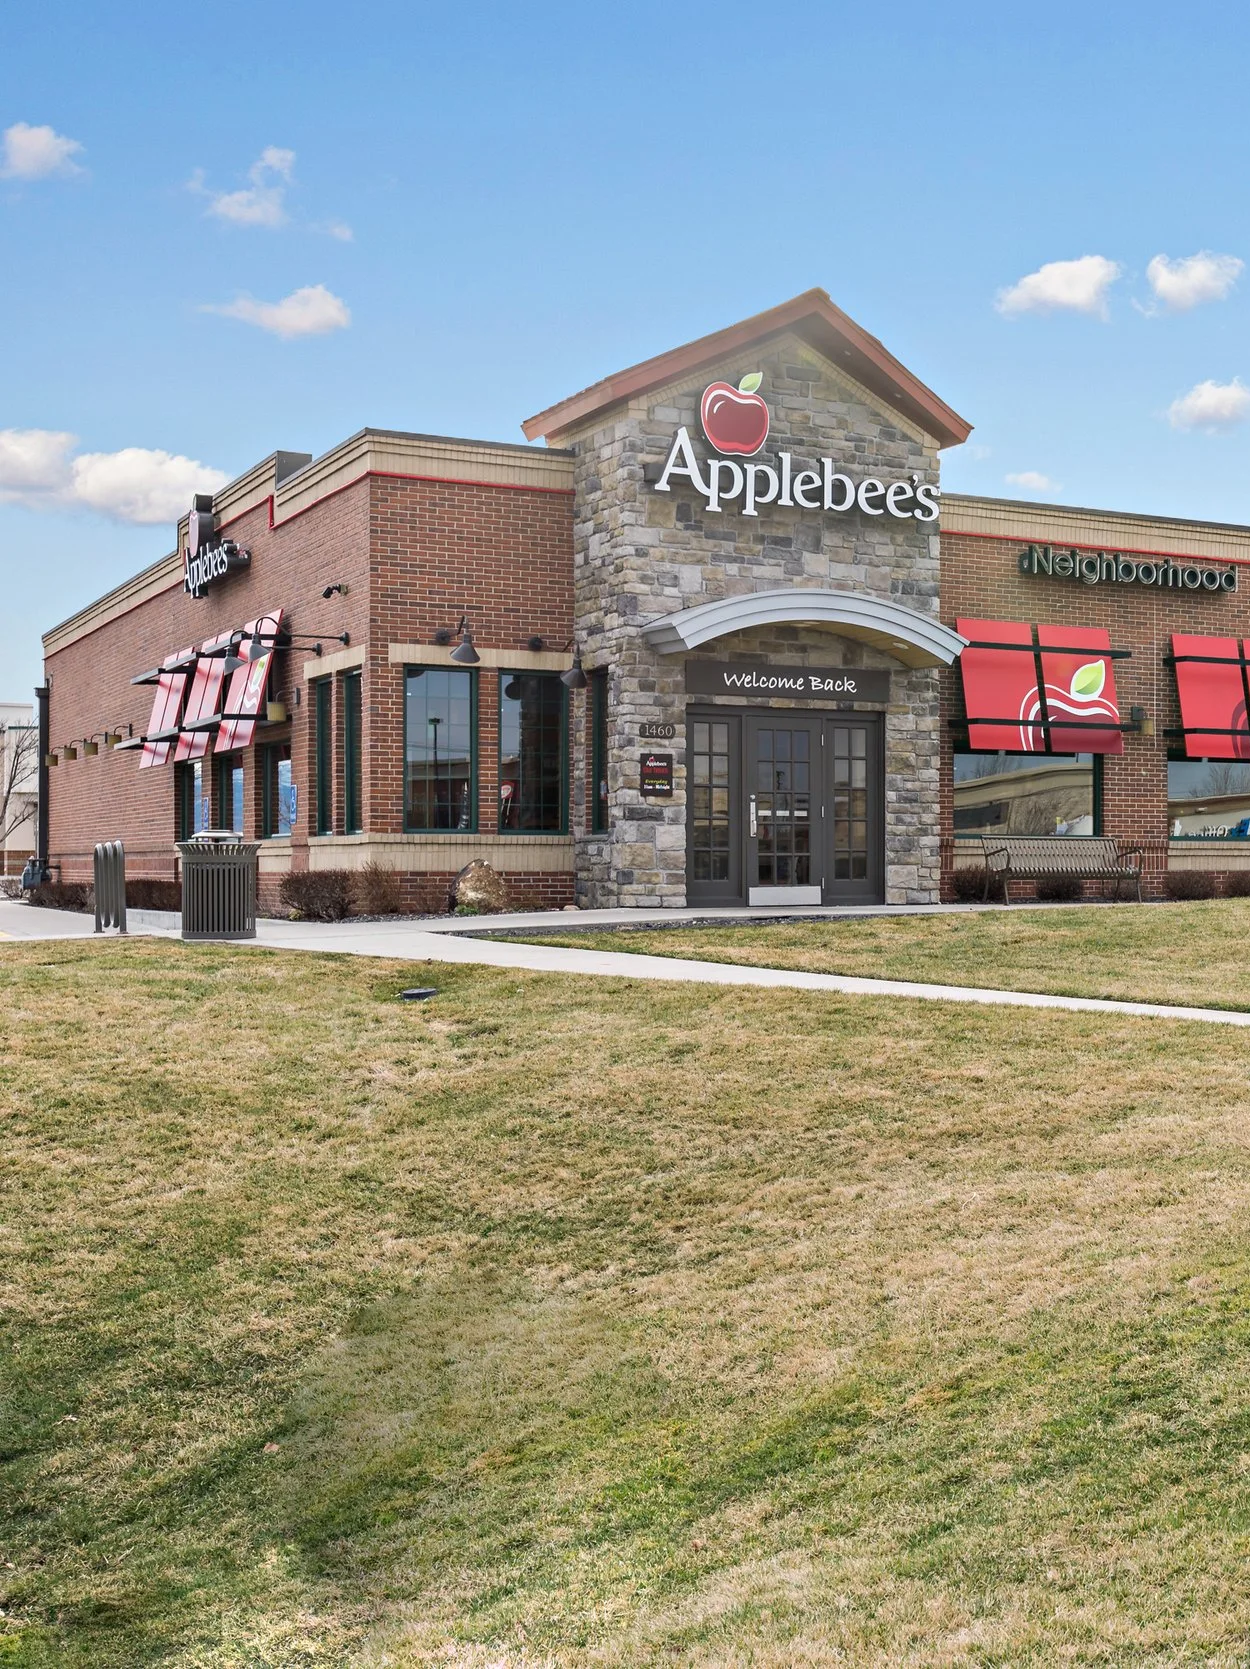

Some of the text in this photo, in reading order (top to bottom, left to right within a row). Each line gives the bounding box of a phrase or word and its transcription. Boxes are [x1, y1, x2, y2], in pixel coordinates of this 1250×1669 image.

[654, 426, 940, 522] Applebee's
[1029, 545, 1239, 593] Neighborhood
[723, 672, 857, 693] Welcome Back
[645, 724, 673, 737] 1460
